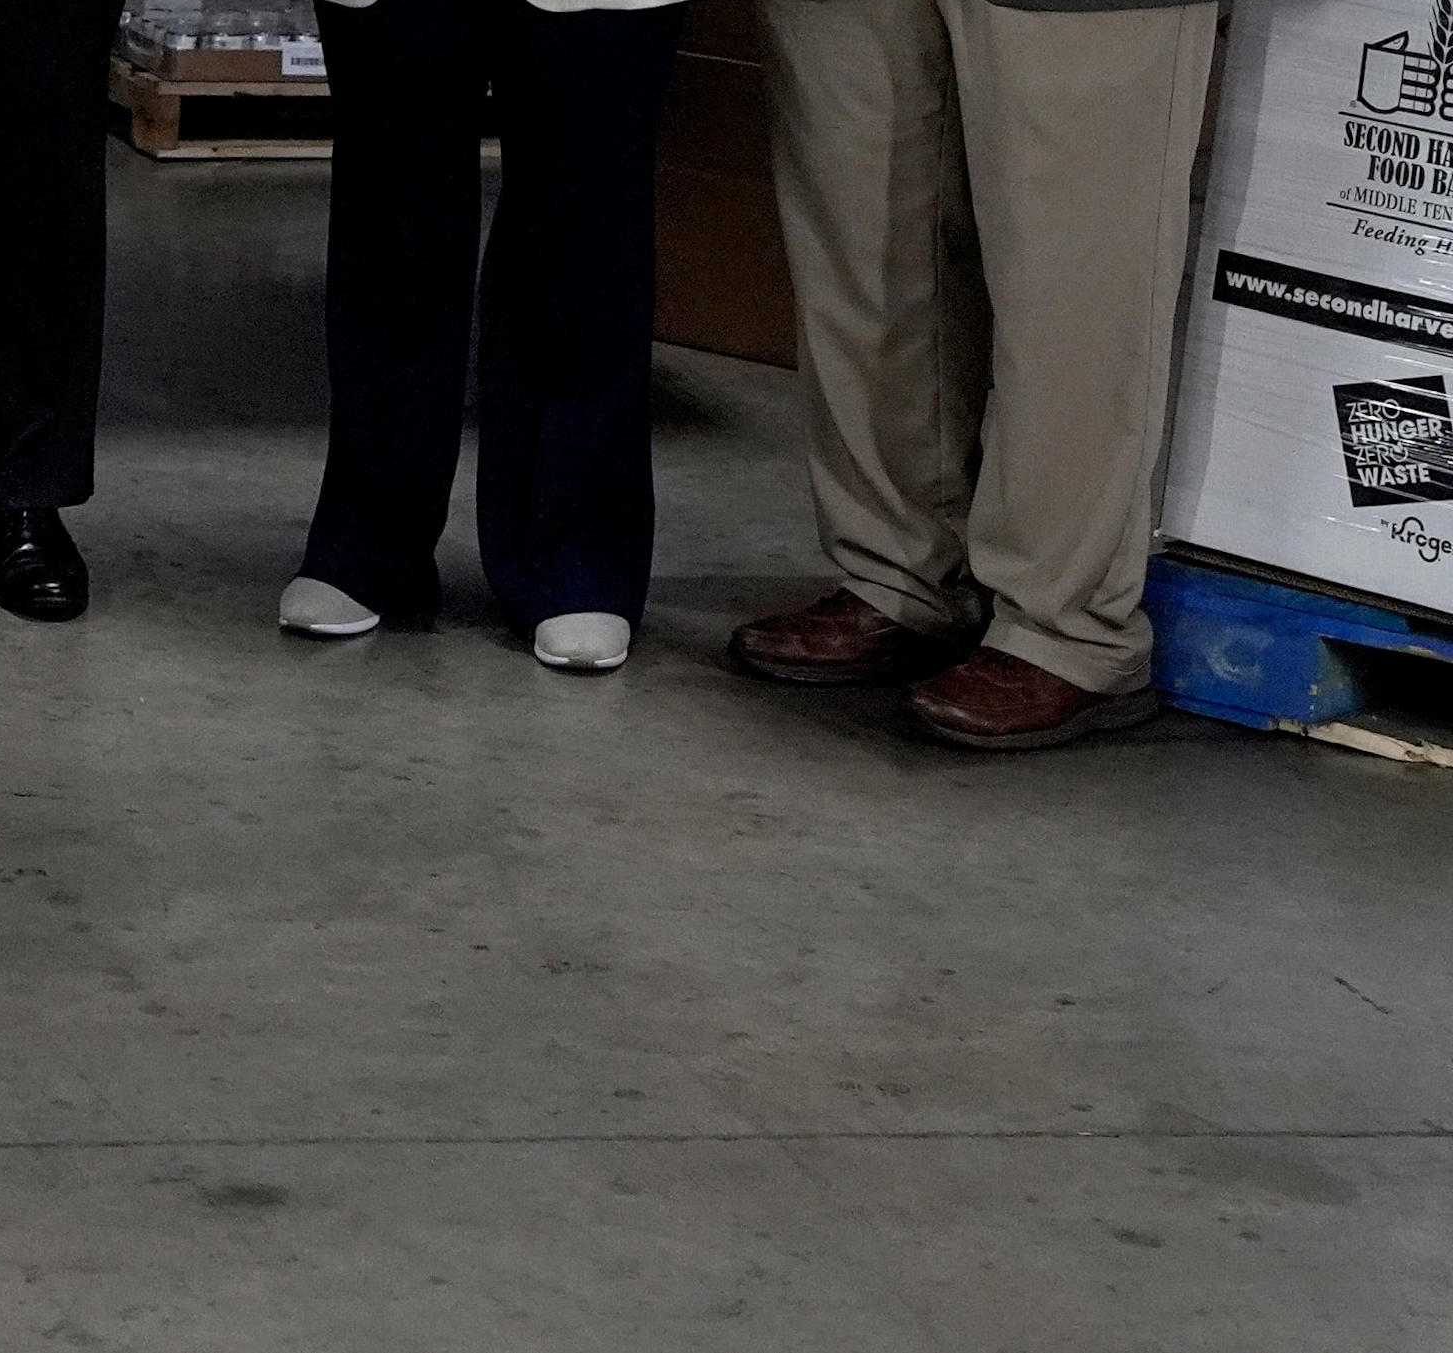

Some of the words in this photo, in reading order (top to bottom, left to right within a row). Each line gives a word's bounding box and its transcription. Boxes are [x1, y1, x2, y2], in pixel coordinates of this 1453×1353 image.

[1344, 121, 1420, 160] SECOND
[1367, 155, 1425, 190] FOOD
[1340, 188, 1351, 200] of
[1354, 187, 1417, 215] MIDDLE
[1353, 218, 1429, 256] Feeding
[1345, 398, 1401, 423] ZERO
[1350, 418, 1444, 444] HUNGER
[1352, 442, 1409, 466] ZERO
[1357, 463, 1432, 488] WASTE
